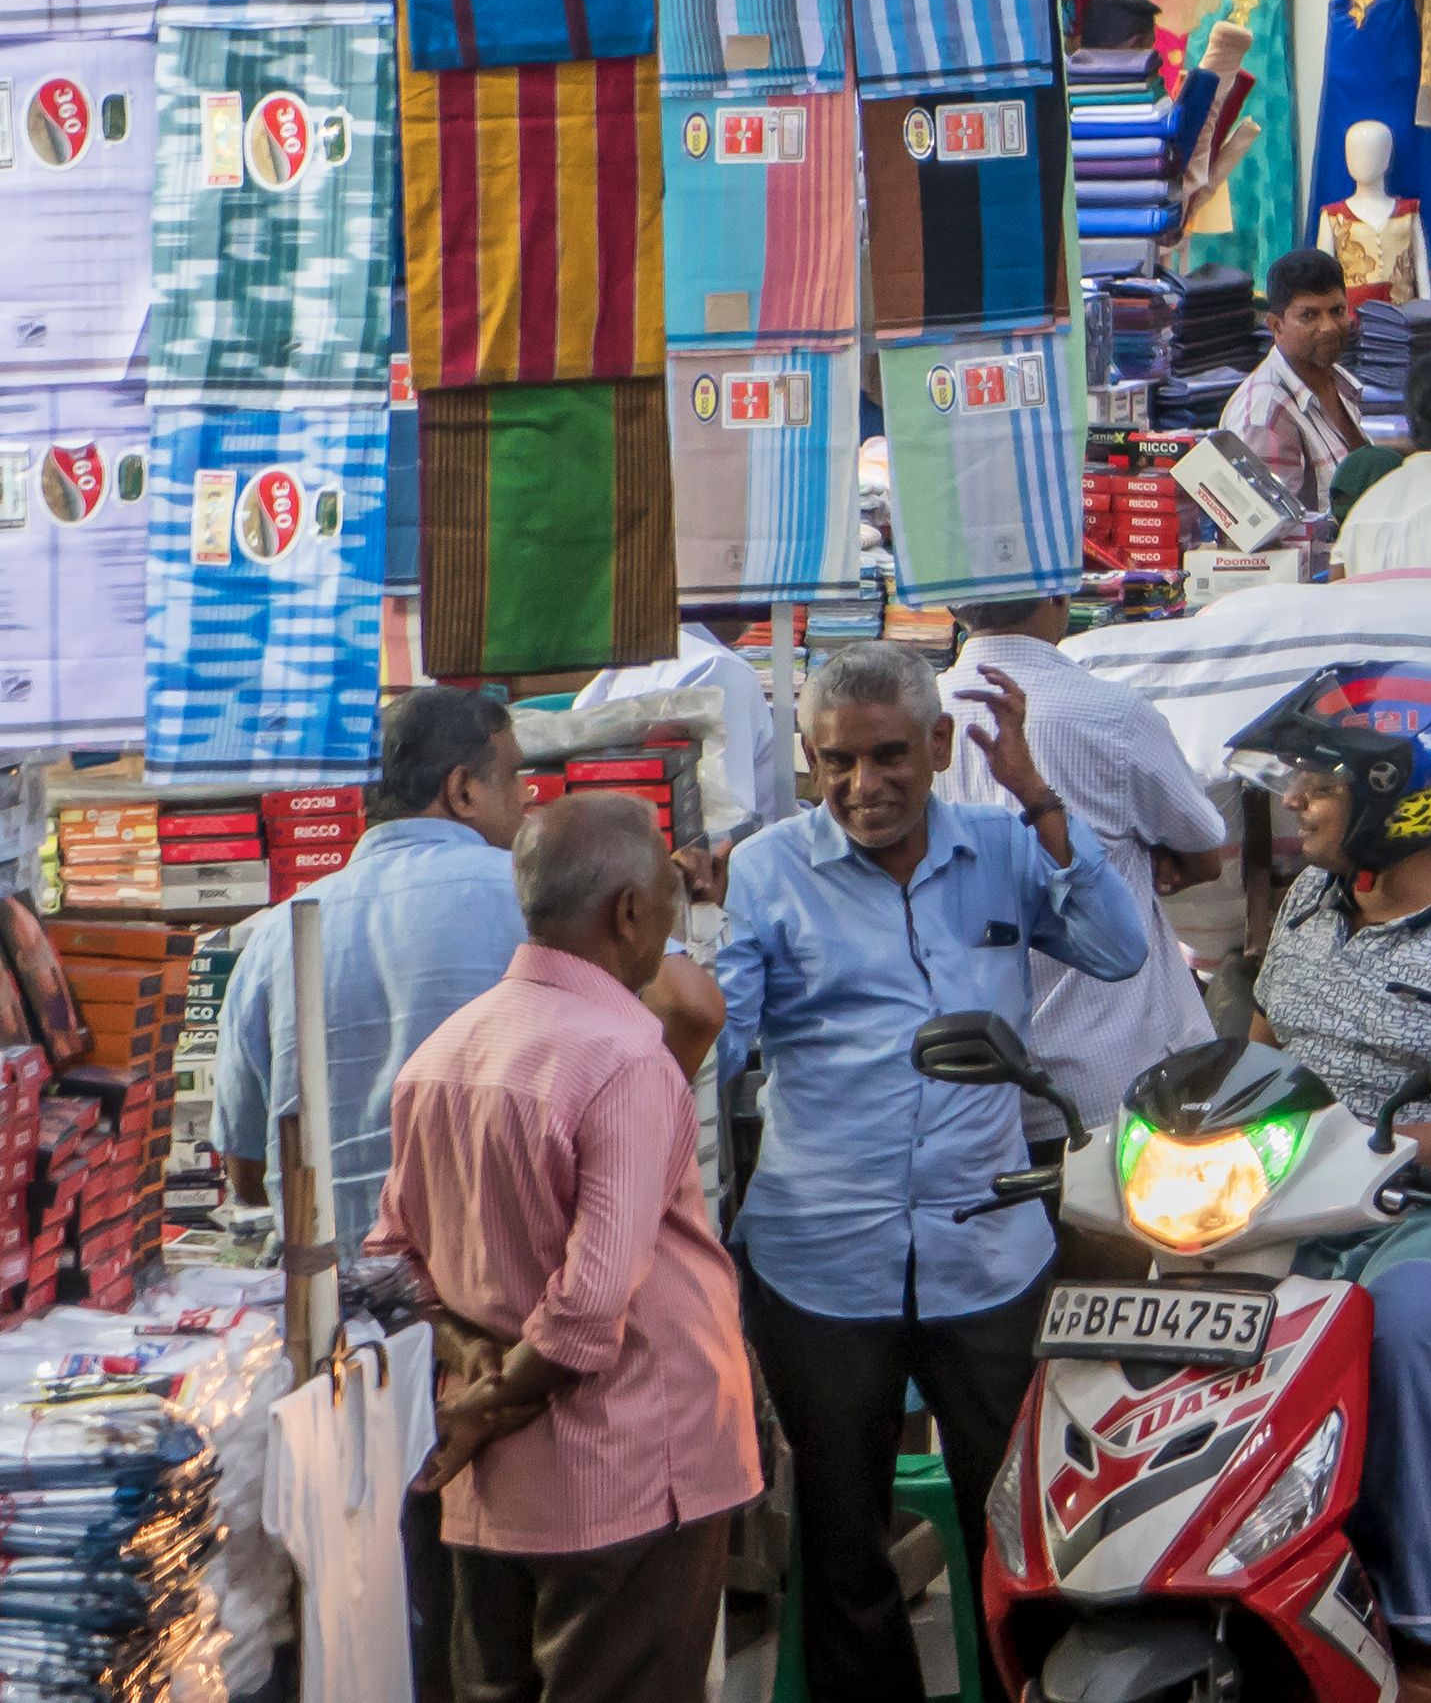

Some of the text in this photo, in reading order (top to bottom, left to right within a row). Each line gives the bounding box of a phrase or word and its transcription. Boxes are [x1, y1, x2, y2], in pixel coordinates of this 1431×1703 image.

[53, 88, 83, 135] 360
[276, 104, 302, 155] 360
[1138, 441, 1179, 453] RICCO
[1127, 481, 1158, 492] RICCO
[270, 479, 294, 529] 360
[1128, 499, 1159, 509] RICCO
[1131, 517, 1162, 528] RICCO
[1129, 534, 1160, 545] RICCO
[1130, 552, 1161, 562] RICCO
[1215, 556, 1268, 566] Poomax
[290, 795, 337, 810] RICCO
[293, 823, 341, 840] RICCO
[295, 852, 343, 868] RICCO
[1048, 1296, 1263, 1345] WP BFD4753
[1136, 1360, 1268, 1444] DASH
